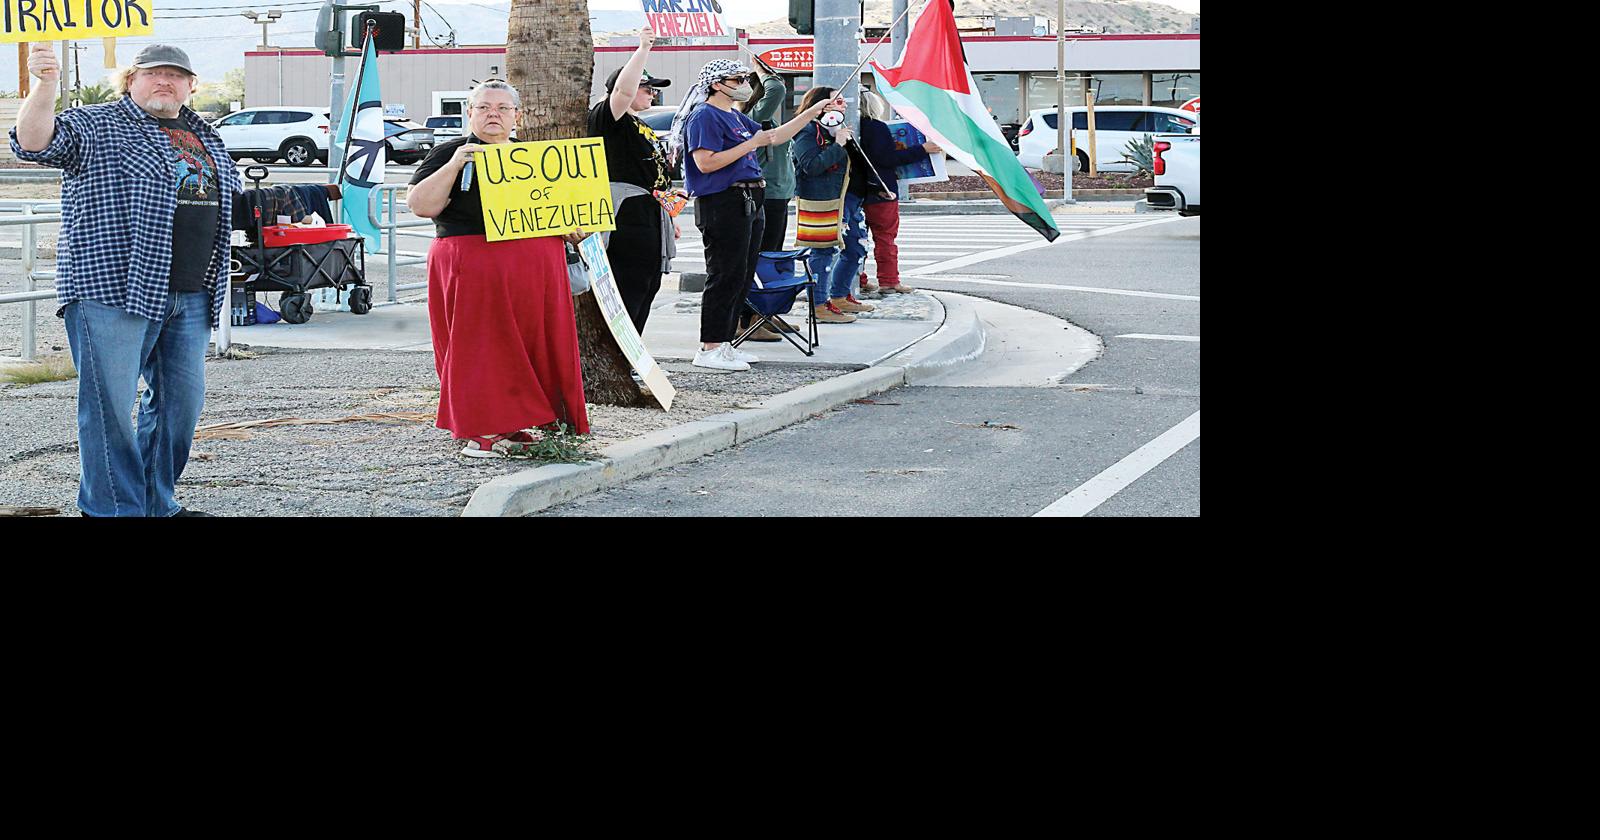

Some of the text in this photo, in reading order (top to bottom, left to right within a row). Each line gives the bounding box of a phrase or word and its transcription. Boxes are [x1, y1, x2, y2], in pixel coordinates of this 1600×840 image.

[4, 0, 149, 33] TRAITOR
[646, 13, 724, 36] VENEZUELA
[483, 143, 601, 185] U.S. OUT
[488, 198, 613, 237] VENEZUELA
